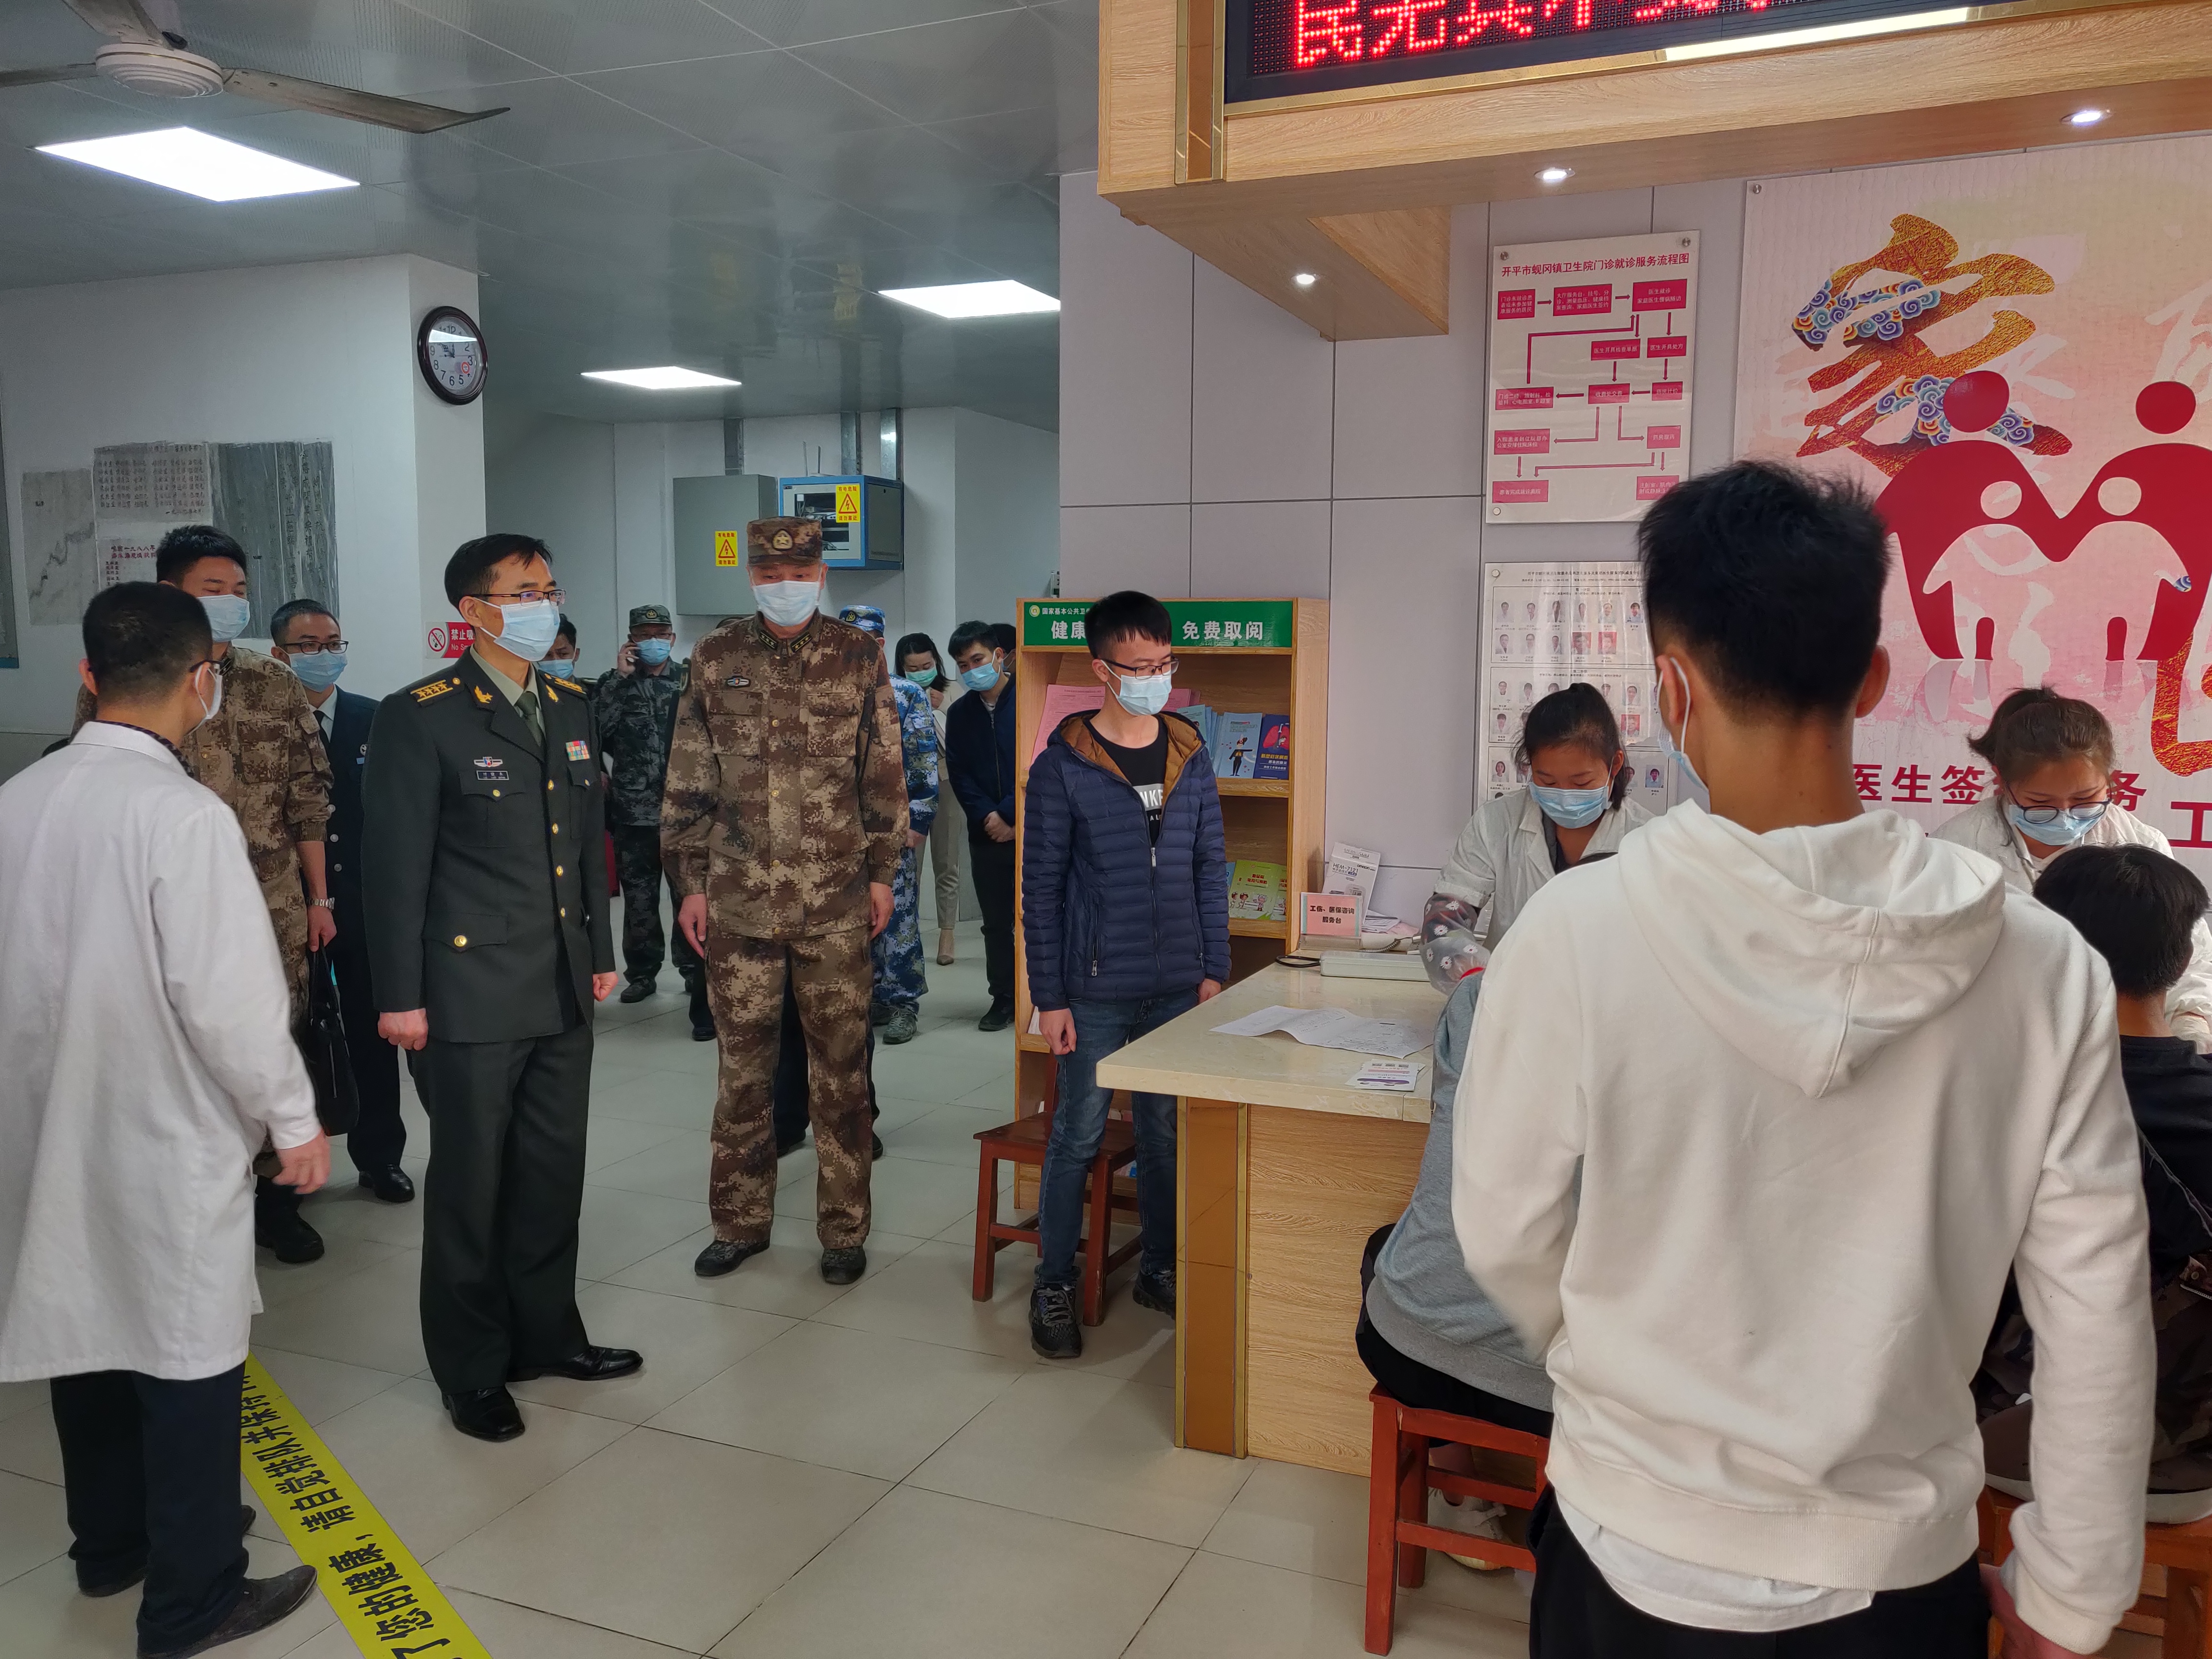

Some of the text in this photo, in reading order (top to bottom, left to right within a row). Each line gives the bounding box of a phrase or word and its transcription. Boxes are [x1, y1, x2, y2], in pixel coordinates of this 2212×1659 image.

[1502, 252, 1689, 277] 开平市蚬冈镇卫生院门诊就诊服务流程图
[433, 360, 439, 370] 8
[441, 370, 446, 380] 7
[449, 375, 455, 385] 6
[458, 374, 464, 385] 5
[451, 629, 475, 640] 禁止吸
[1182, 621, 1263, 640] 免费取阅
[1852, 763, 2148, 812] 医生签务
[1333, 863, 1358, 873] HEM-7121
[1310, 905, 1355, 914] 工伤、医保咨询
[241, 1374, 451, 1659] 了您的健康，请自觉排队并保持
